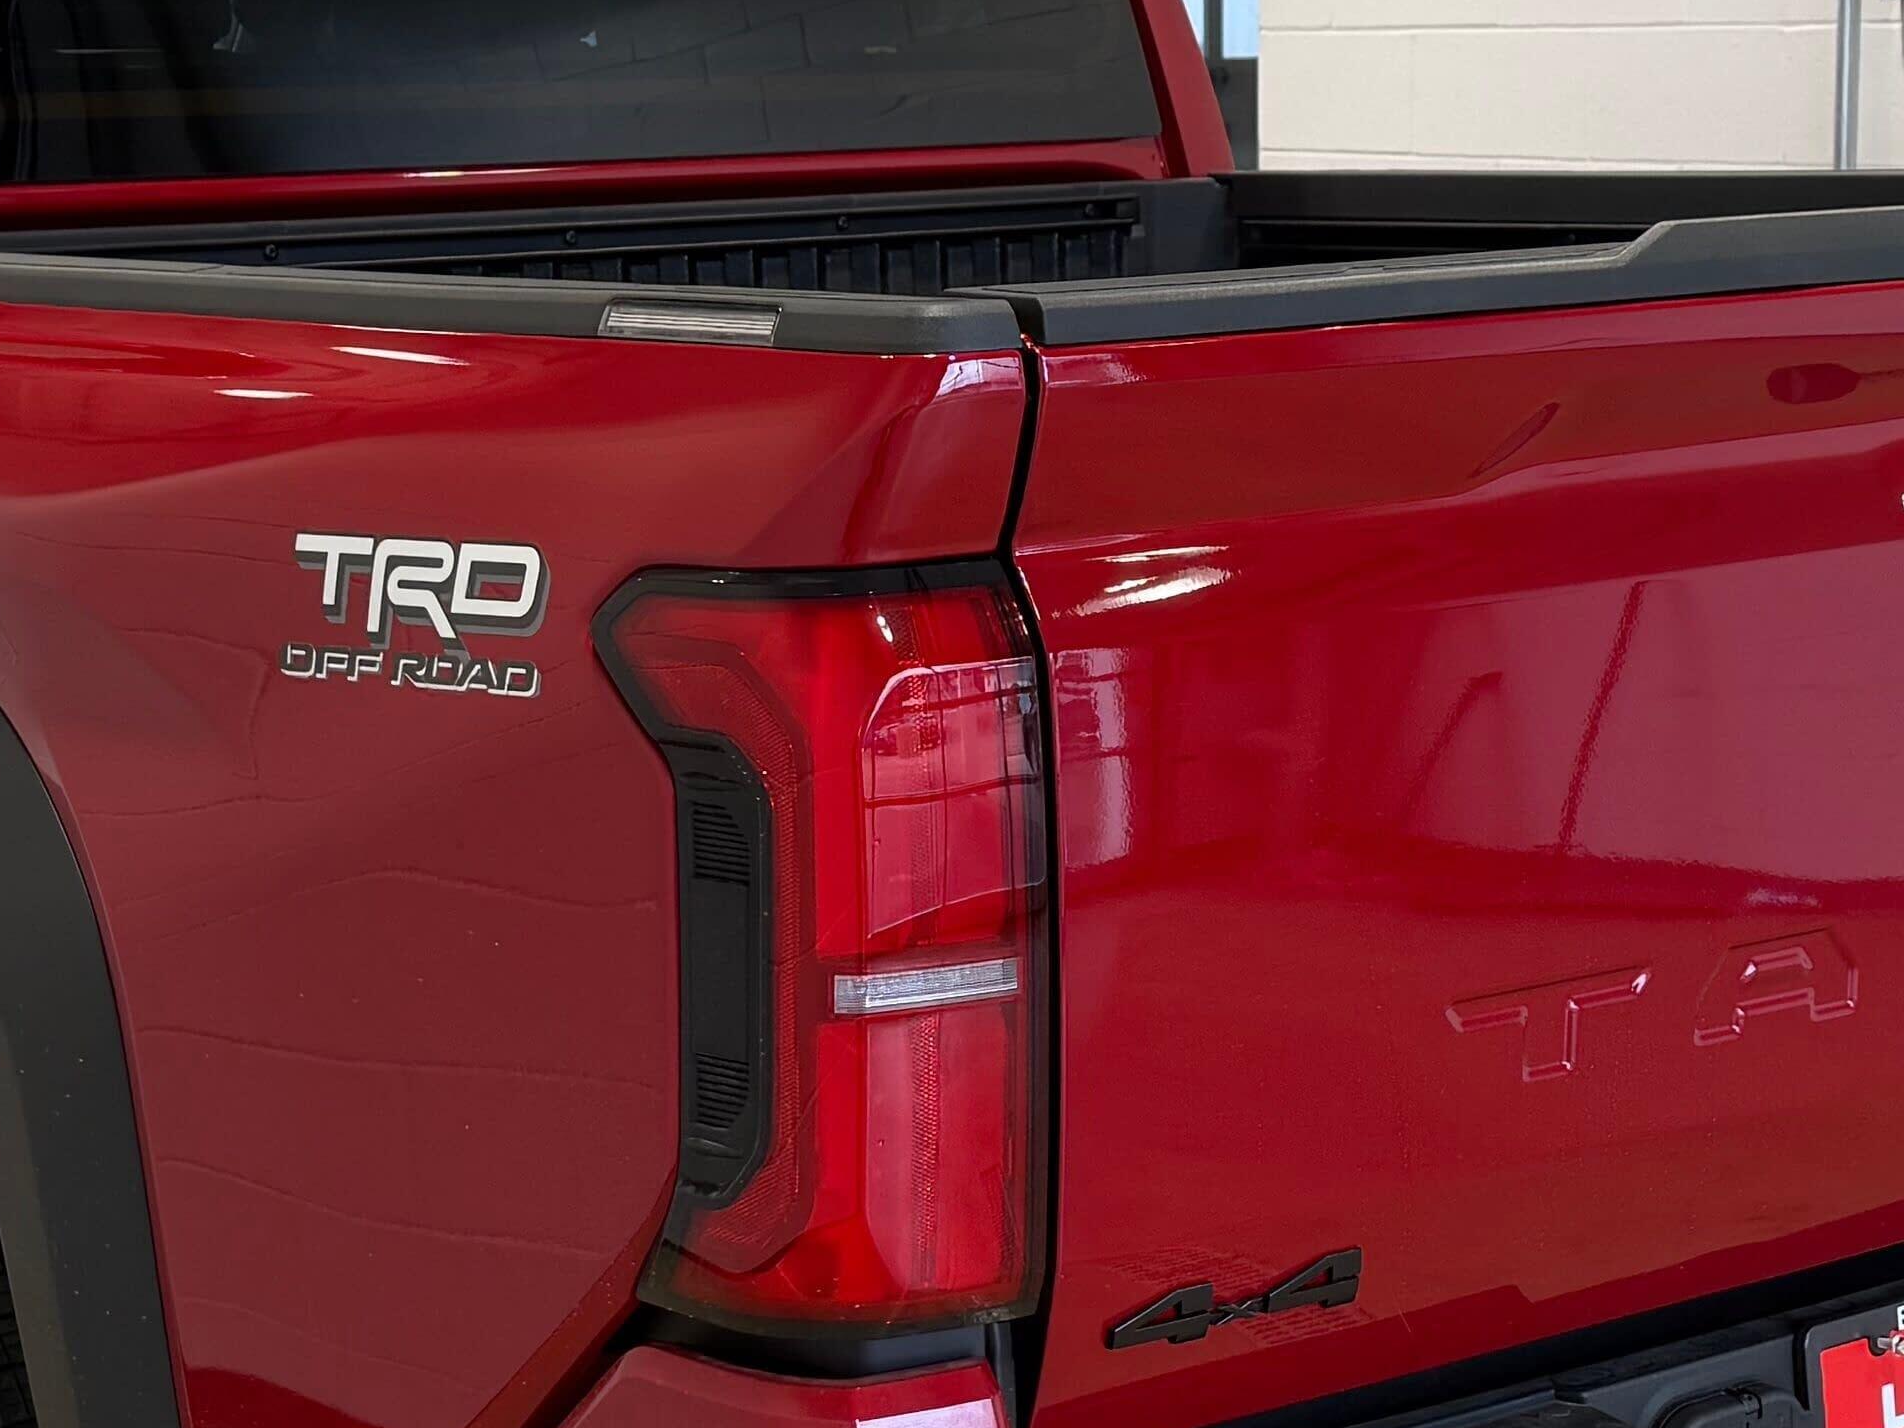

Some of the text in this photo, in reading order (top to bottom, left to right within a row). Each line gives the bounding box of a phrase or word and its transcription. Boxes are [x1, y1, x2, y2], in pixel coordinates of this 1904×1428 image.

[294, 532, 546, 648] TRD
[280, 642, 540, 699] OFF ROAD
